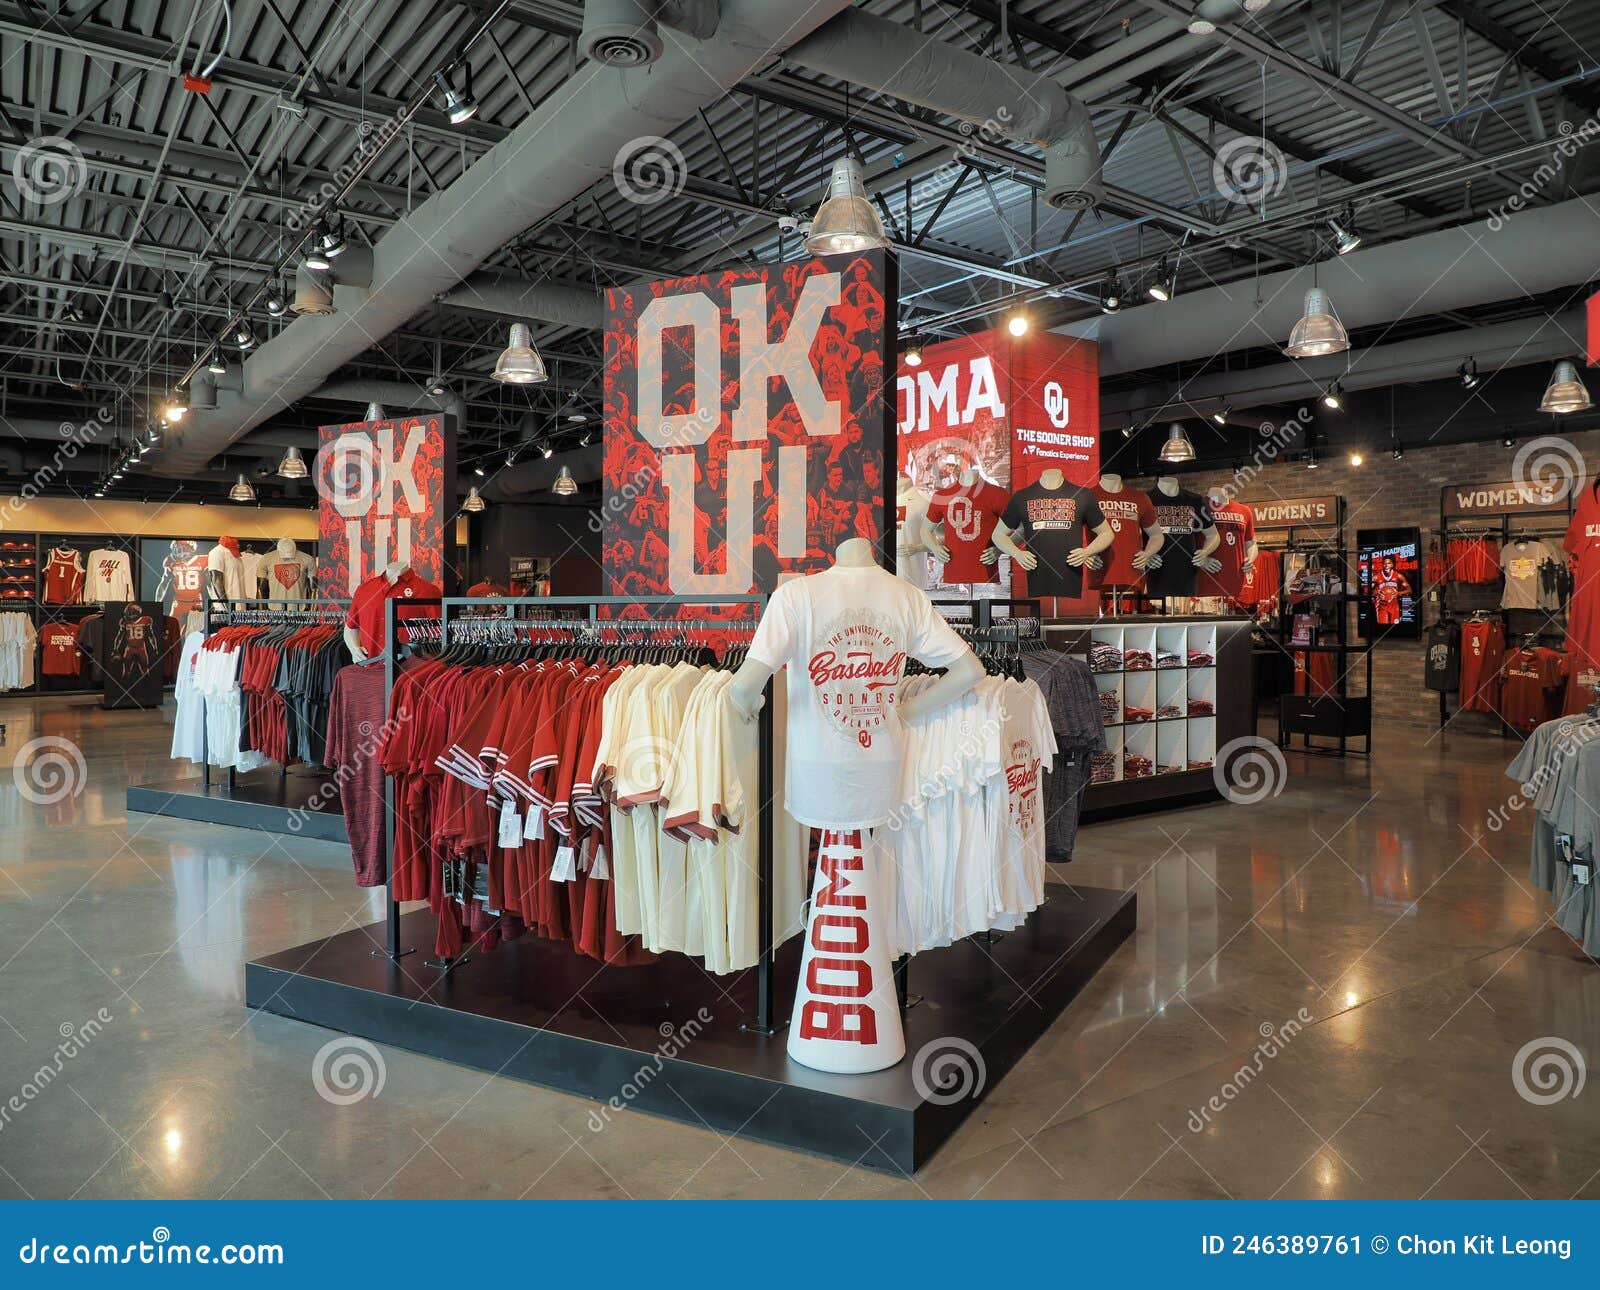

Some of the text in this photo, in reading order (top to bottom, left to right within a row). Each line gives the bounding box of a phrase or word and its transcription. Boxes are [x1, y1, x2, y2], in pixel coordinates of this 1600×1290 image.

[637, 271, 841, 449] OK
[1043, 381, 1069, 428] OU
[1016, 429, 1095, 448] THE SOONER SHOP
[1023, 447, 1089, 461] A Fanatics Experience
[334, 425, 426, 517] OK
[1027, 498, 1076, 510] BOOMER
[1098, 500, 1138, 513] OONER
[1456, 487, 1554, 509] WOMEN'S
[947, 497, 982, 541] OU
[1028, 510, 1075, 521] SOONER
[1254, 503, 1326, 521] WOMEN'S
[1226, 532, 1236, 546] OU
[177, 570, 199, 590] 18
[829, 625, 895, 647] THE UNIVERSITY OF
[859, 730, 872, 748] OU
